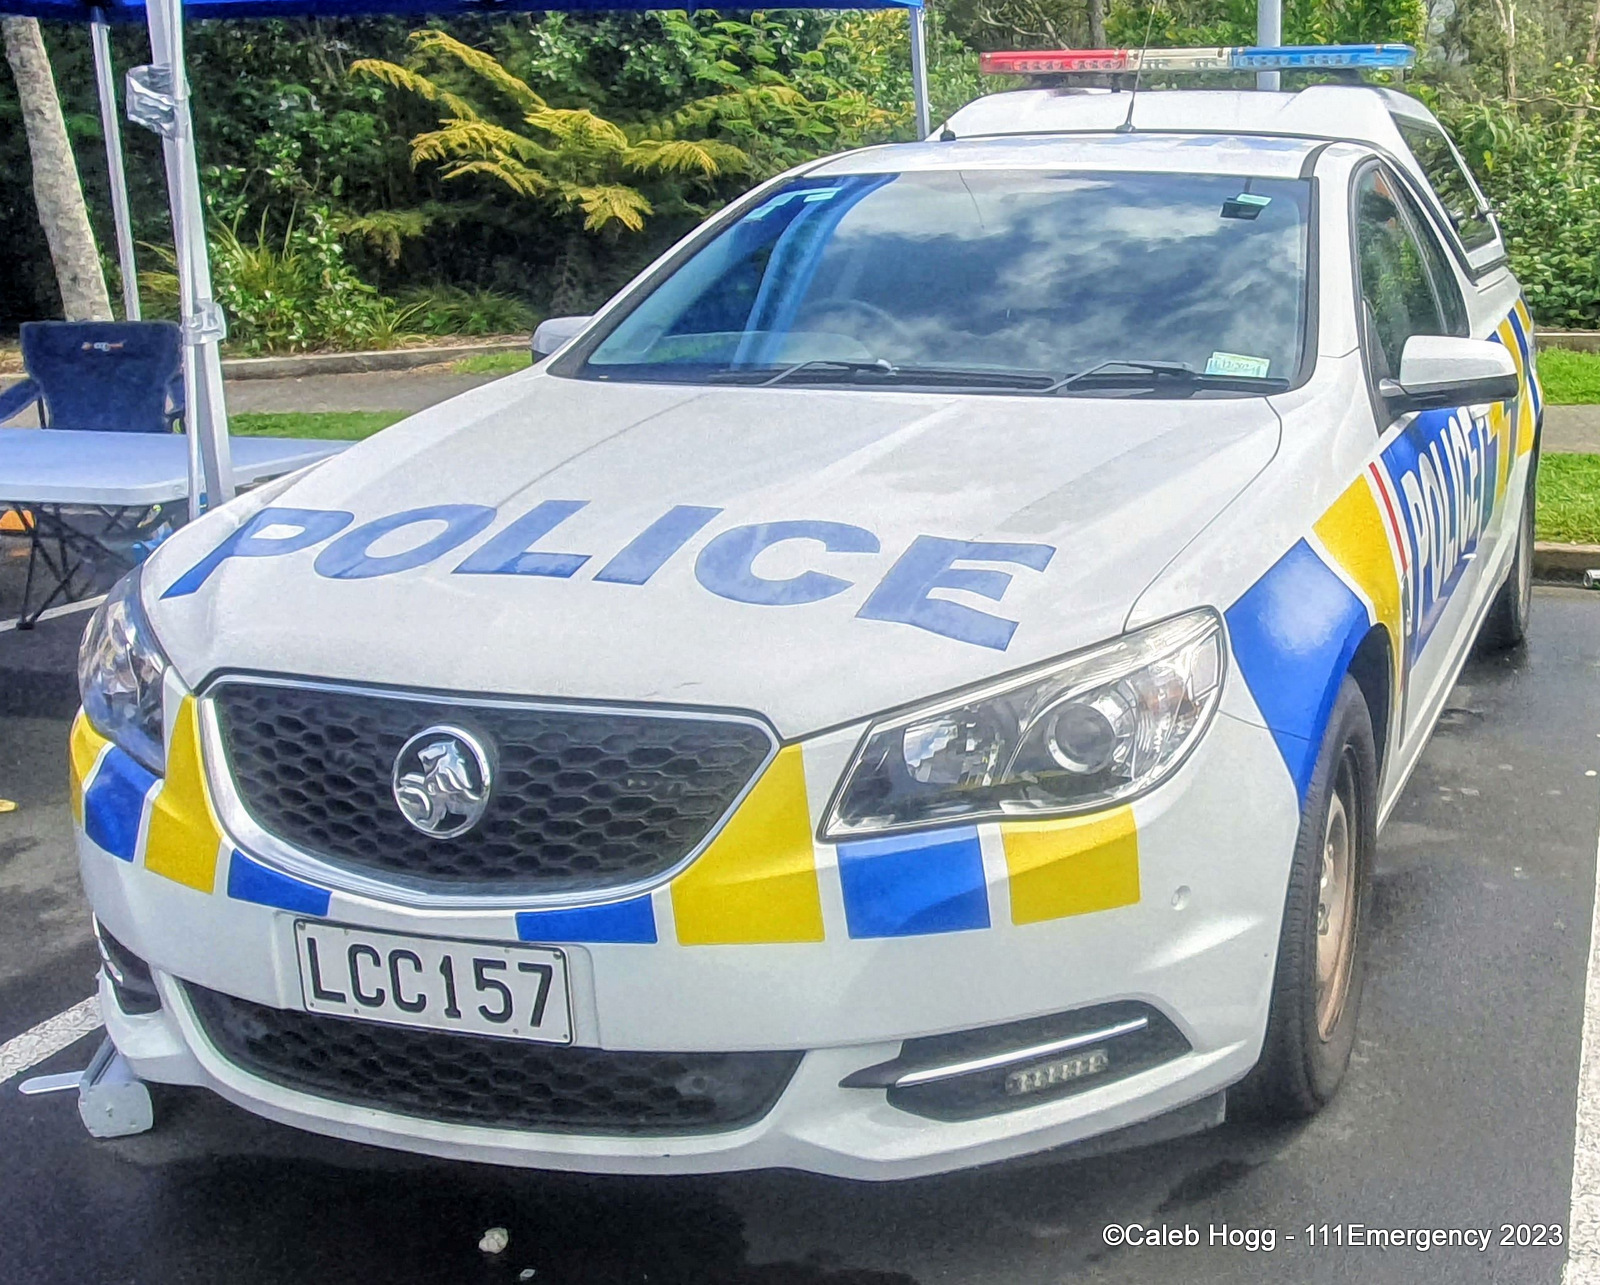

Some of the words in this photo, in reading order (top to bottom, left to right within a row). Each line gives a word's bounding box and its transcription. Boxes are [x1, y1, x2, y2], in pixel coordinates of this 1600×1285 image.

[161, 499, 1056, 651] POLICE
[1400, 406, 1479, 631] POLICE
[306, 937, 553, 1027] LCC157
